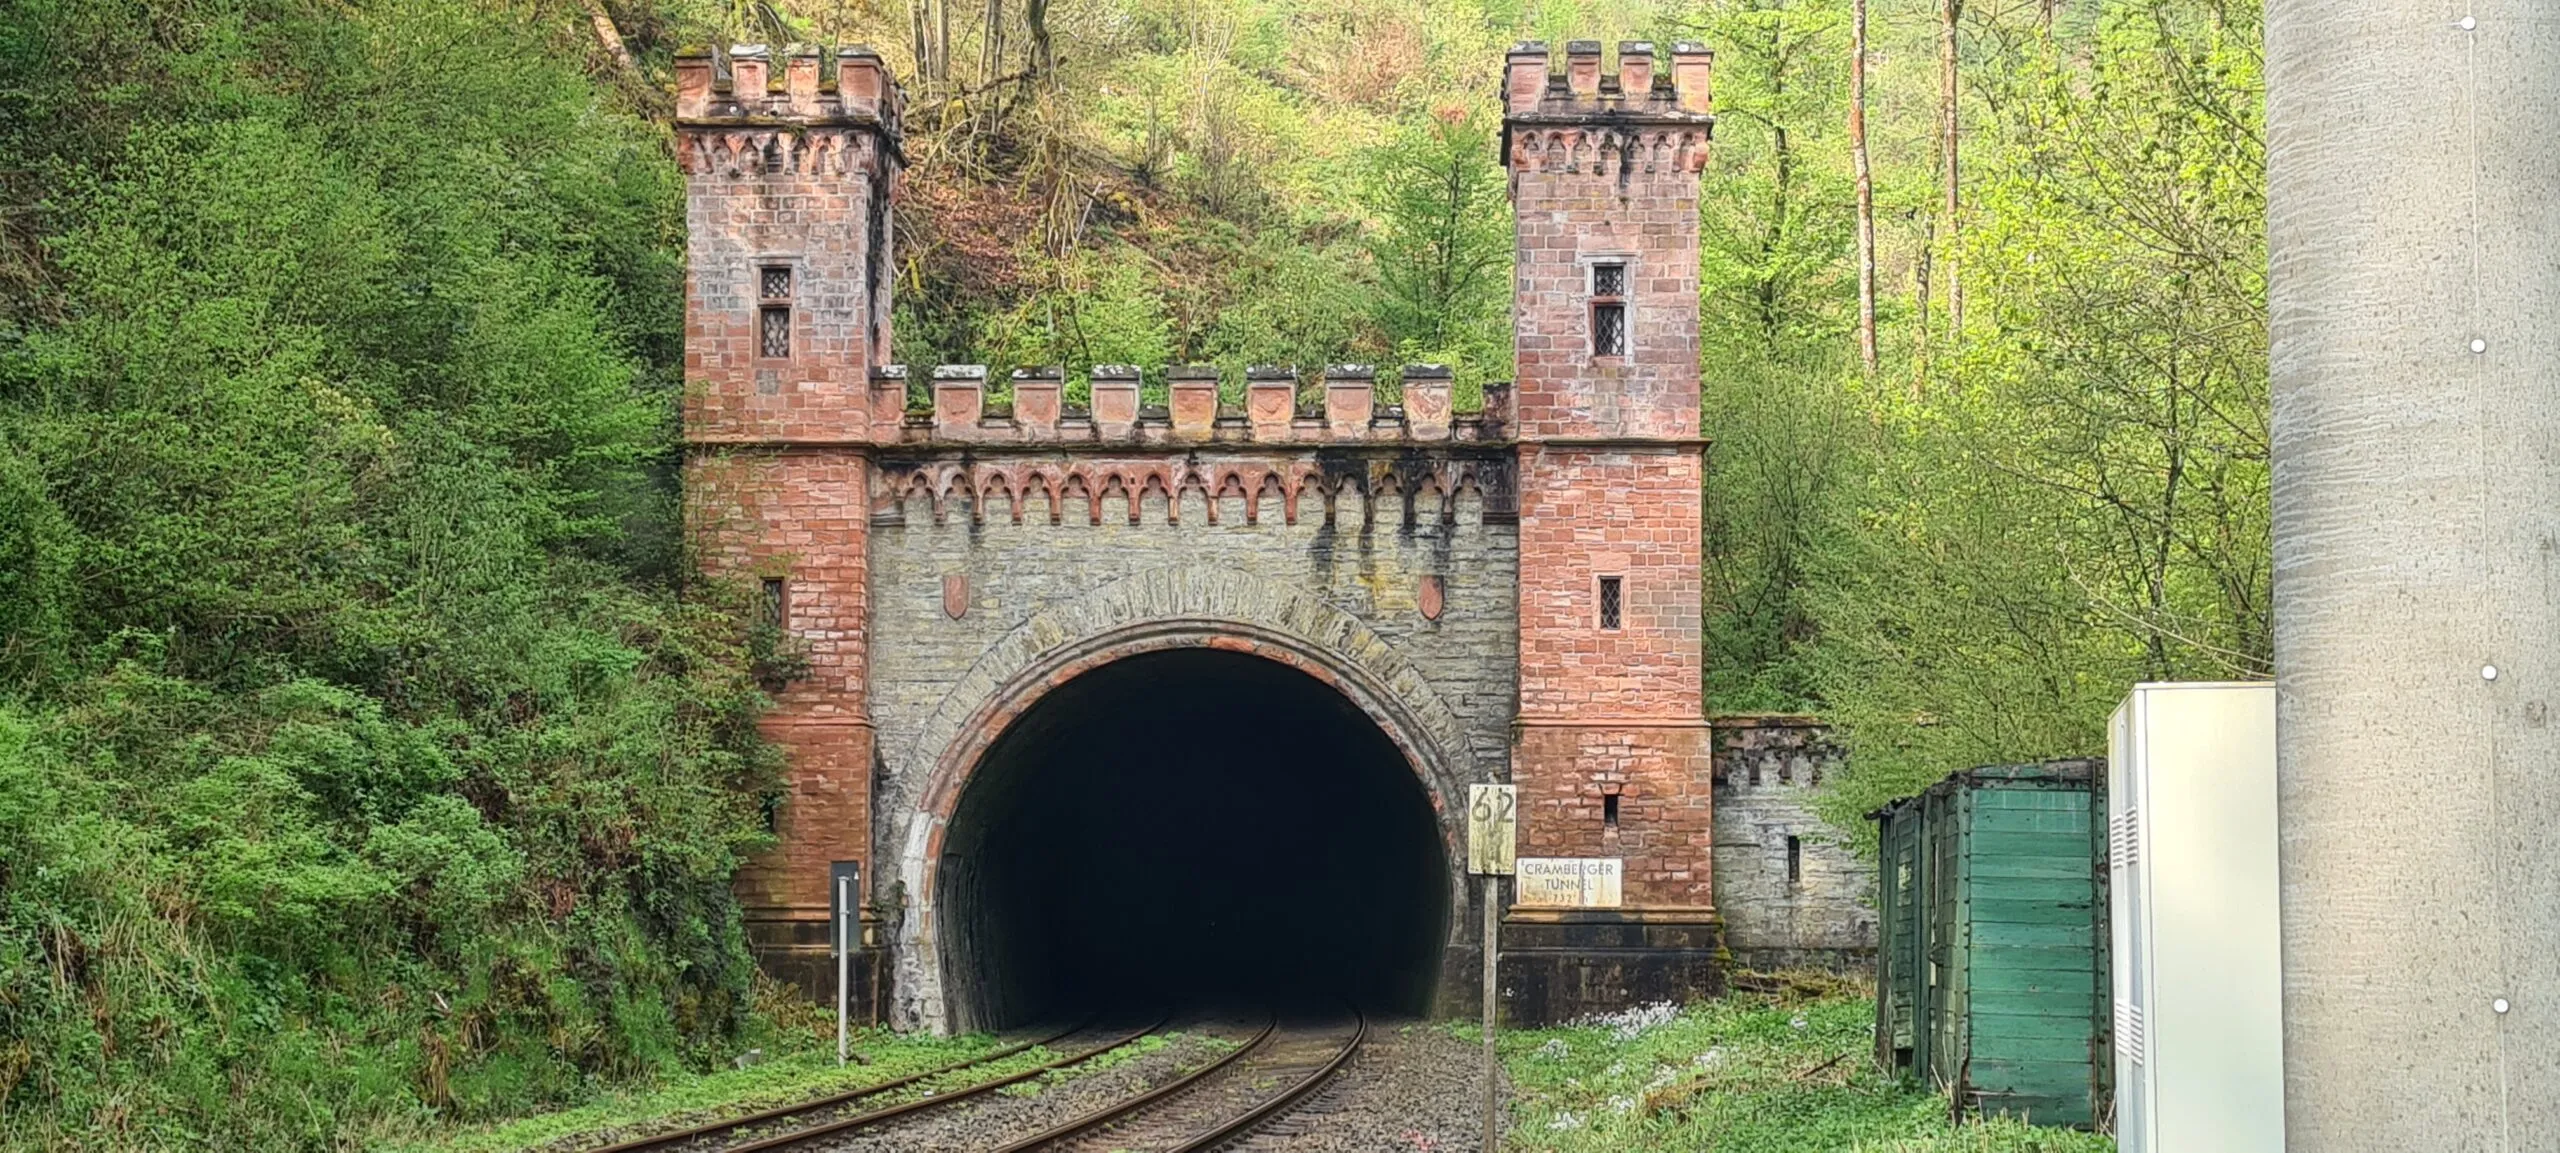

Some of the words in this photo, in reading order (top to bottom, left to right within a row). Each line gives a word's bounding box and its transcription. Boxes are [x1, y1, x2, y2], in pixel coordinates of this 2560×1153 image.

[1472, 787, 1514, 823] 62
[1525, 863, 1614, 875] CRAMBERGER
[1545, 878, 1594, 890] TUNNEL
